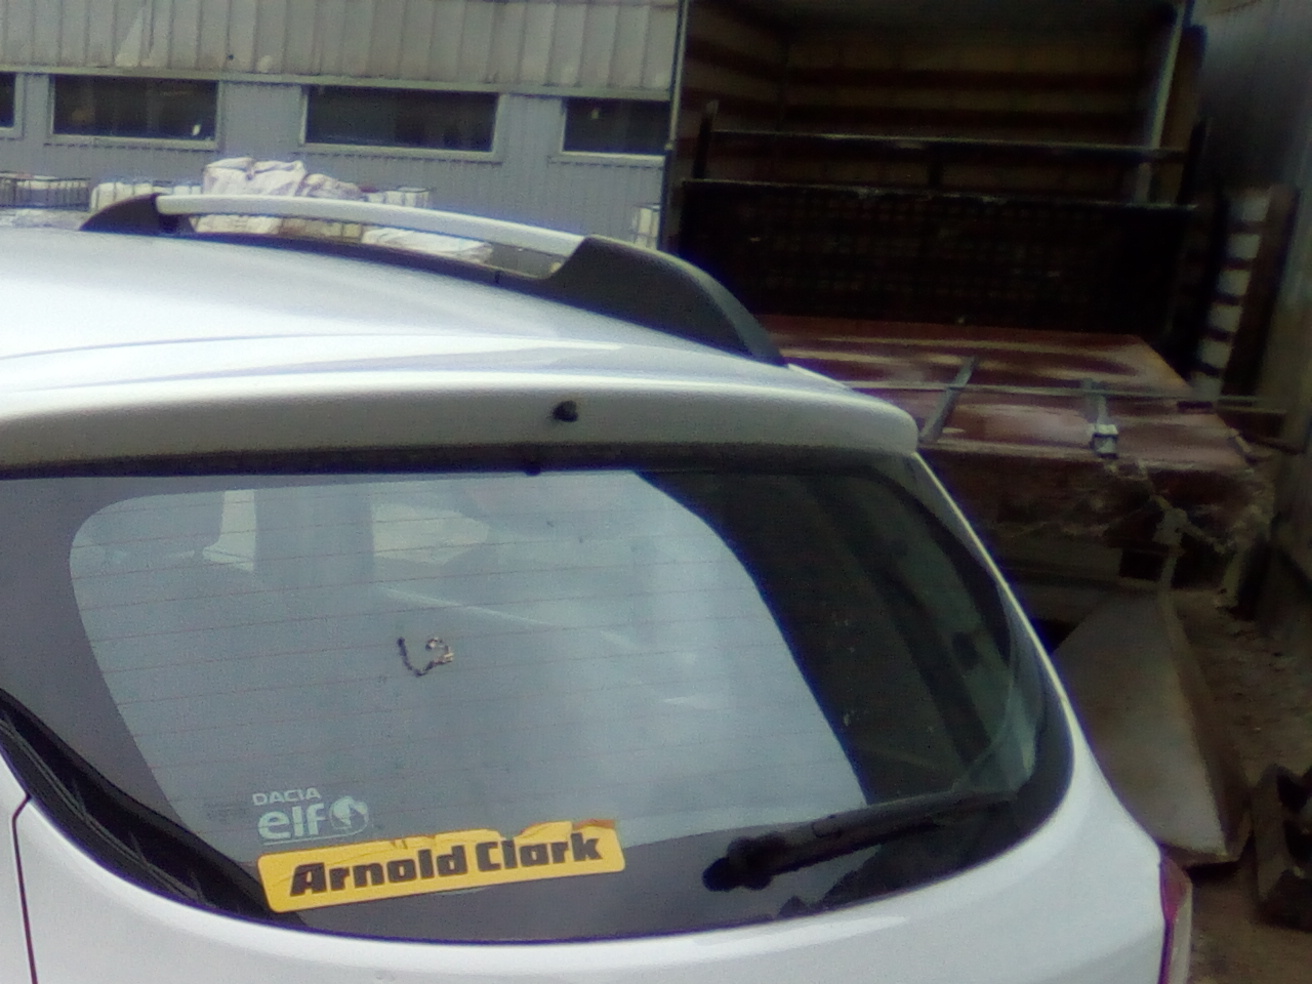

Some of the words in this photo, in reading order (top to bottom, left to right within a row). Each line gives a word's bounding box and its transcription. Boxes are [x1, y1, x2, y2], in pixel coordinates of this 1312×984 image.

[252, 787, 322, 806] DACIA
[258, 803, 326, 839] elf
[290, 845, 468, 897] Arnold
[475, 832, 604, 873] Clark
